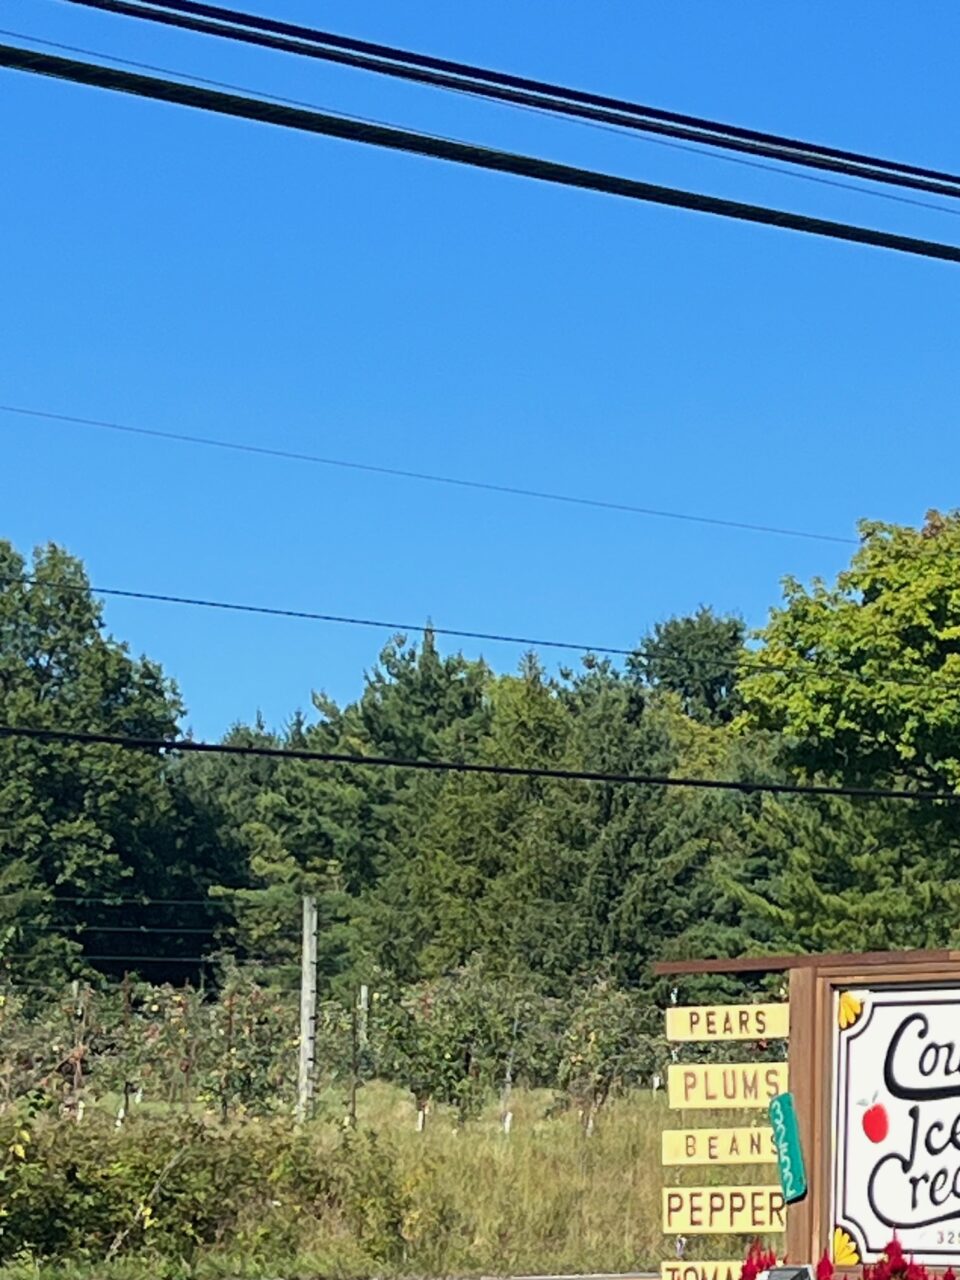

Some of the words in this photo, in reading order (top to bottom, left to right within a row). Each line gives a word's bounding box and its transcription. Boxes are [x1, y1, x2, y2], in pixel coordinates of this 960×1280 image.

[689, 1010, 767, 1035] PEARS
[683, 1069, 780, 1101] PLUMS
[667, 1191, 786, 1227] PEPPER
